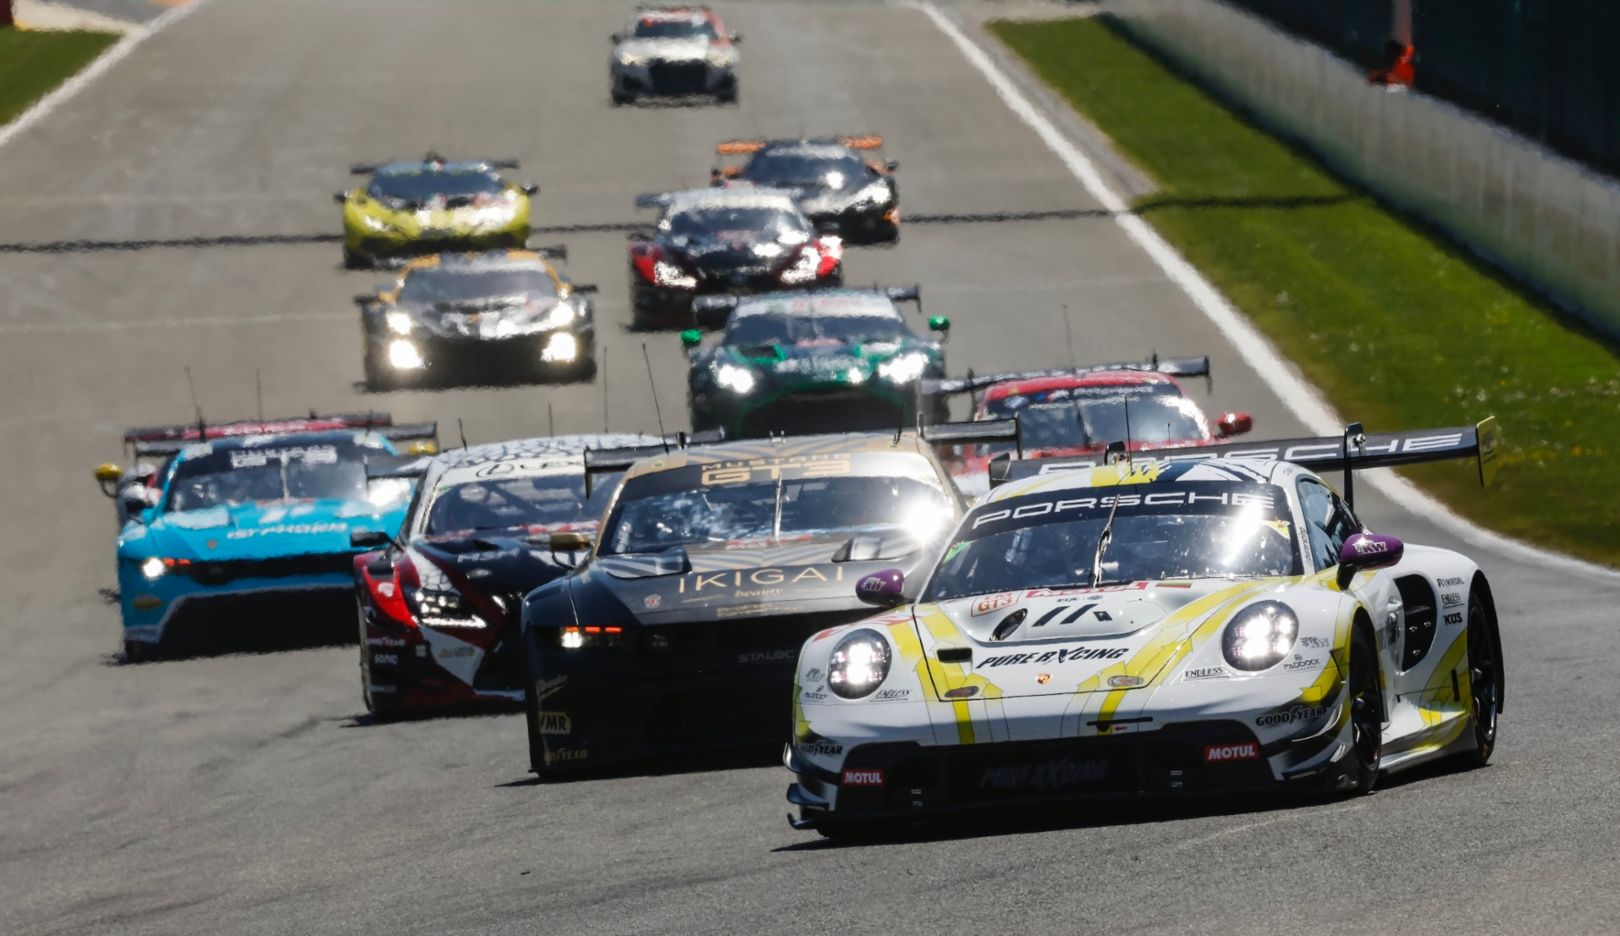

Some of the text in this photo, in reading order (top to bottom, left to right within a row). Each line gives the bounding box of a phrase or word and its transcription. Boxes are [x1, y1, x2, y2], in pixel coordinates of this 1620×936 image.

[702, 453, 850, 471] MUSTANG
[702, 459, 850, 486] GT3
[971, 492, 1275, 529] PORSCHE
[679, 566, 843, 593] IKIGAI
[976, 652, 1038, 669] PURE
[1185, 667, 1223, 678] ENDLESS
[1208, 745, 1255, 761] MOTUL
[845, 771, 882, 784] MOTUL
